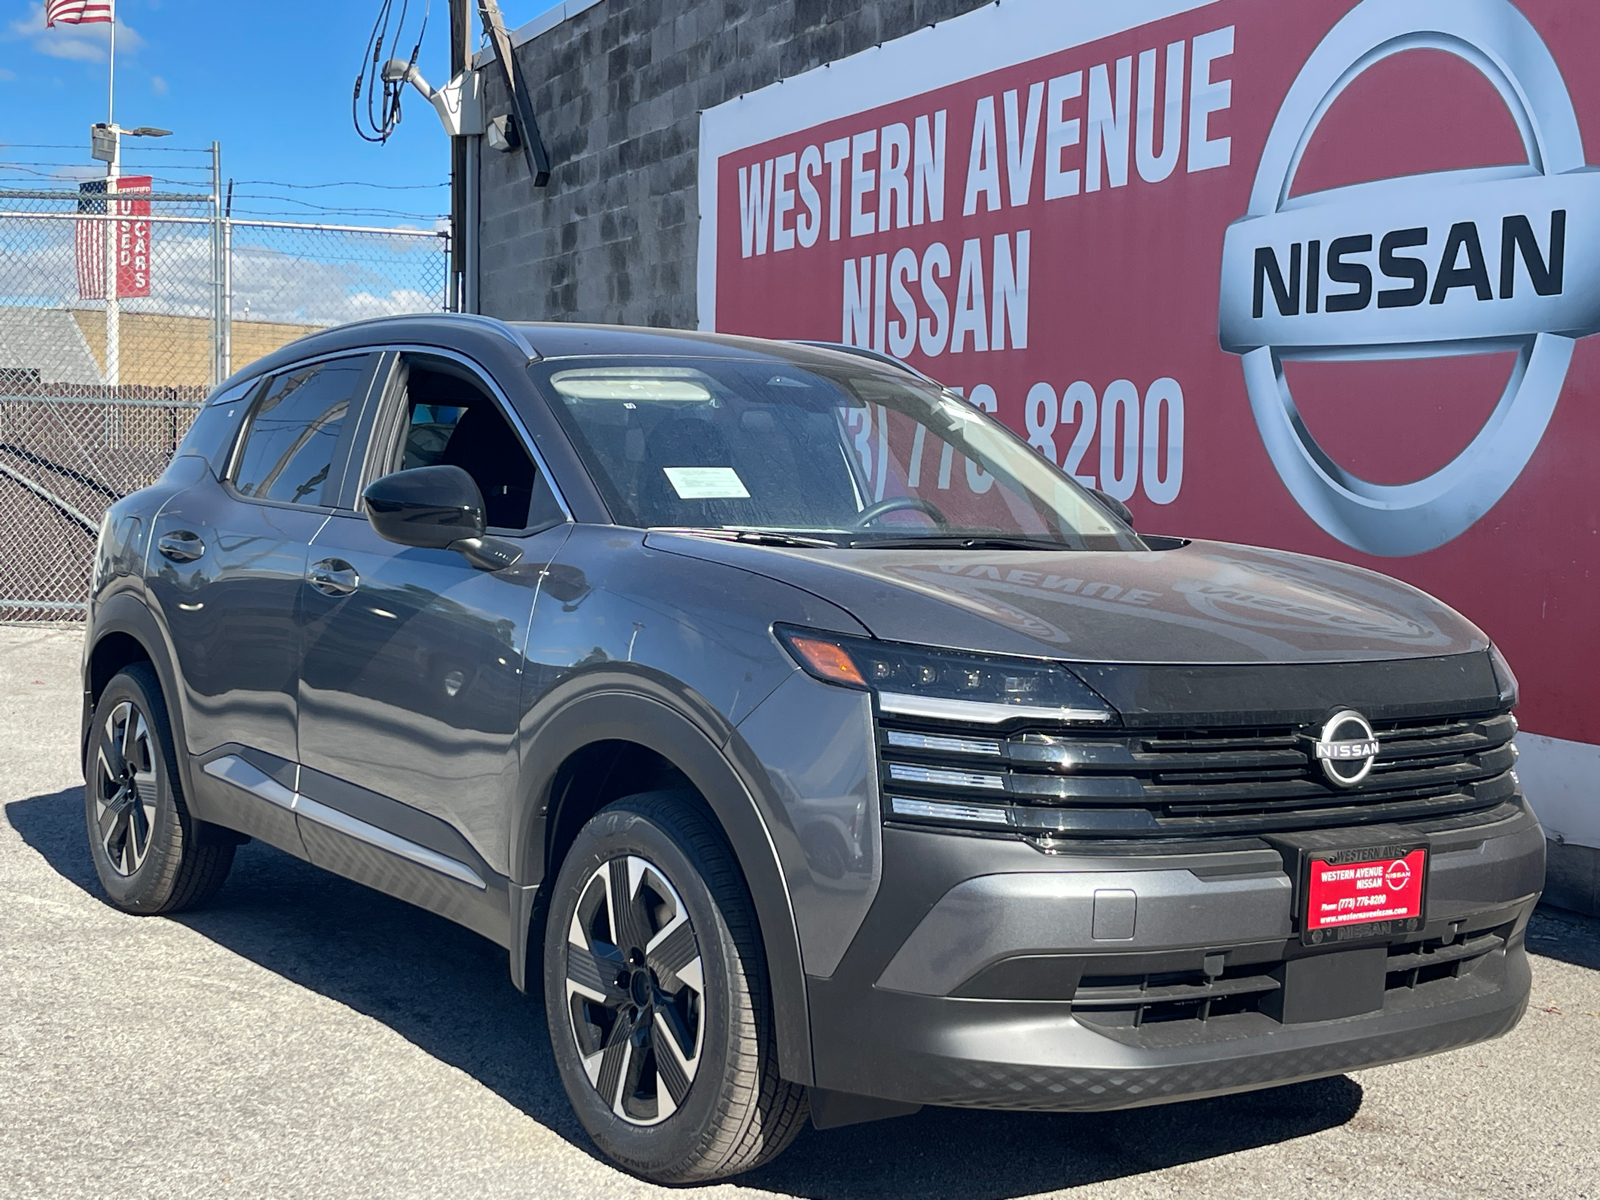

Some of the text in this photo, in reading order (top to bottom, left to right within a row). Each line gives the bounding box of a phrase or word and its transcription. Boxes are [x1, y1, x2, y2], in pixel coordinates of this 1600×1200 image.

[738, 25, 1235, 259] WESTERN AVENUE
[120, 199, 132, 266] USED
[134, 221, 147, 289] CARS
[1252, 209, 1566, 319] NISSAN
[842, 230, 1031, 358] NISSAN
[1319, 741, 1379, 757] NISSAN
[1336, 844, 1401, 863] WESTERN AVE
[1321, 866, 1384, 882] WESTERN AVENUE
[1356, 878, 1383, 889] NISSAN
[1385, 871, 1411, 879] NISSAN
[1338, 897, 1355, 911] (773)
[1356, 894, 1386, 907] 776-8200
[1320, 907, 1408, 924] www.westernavenissan.com
[1338, 921, 1392, 940] NISSAN
